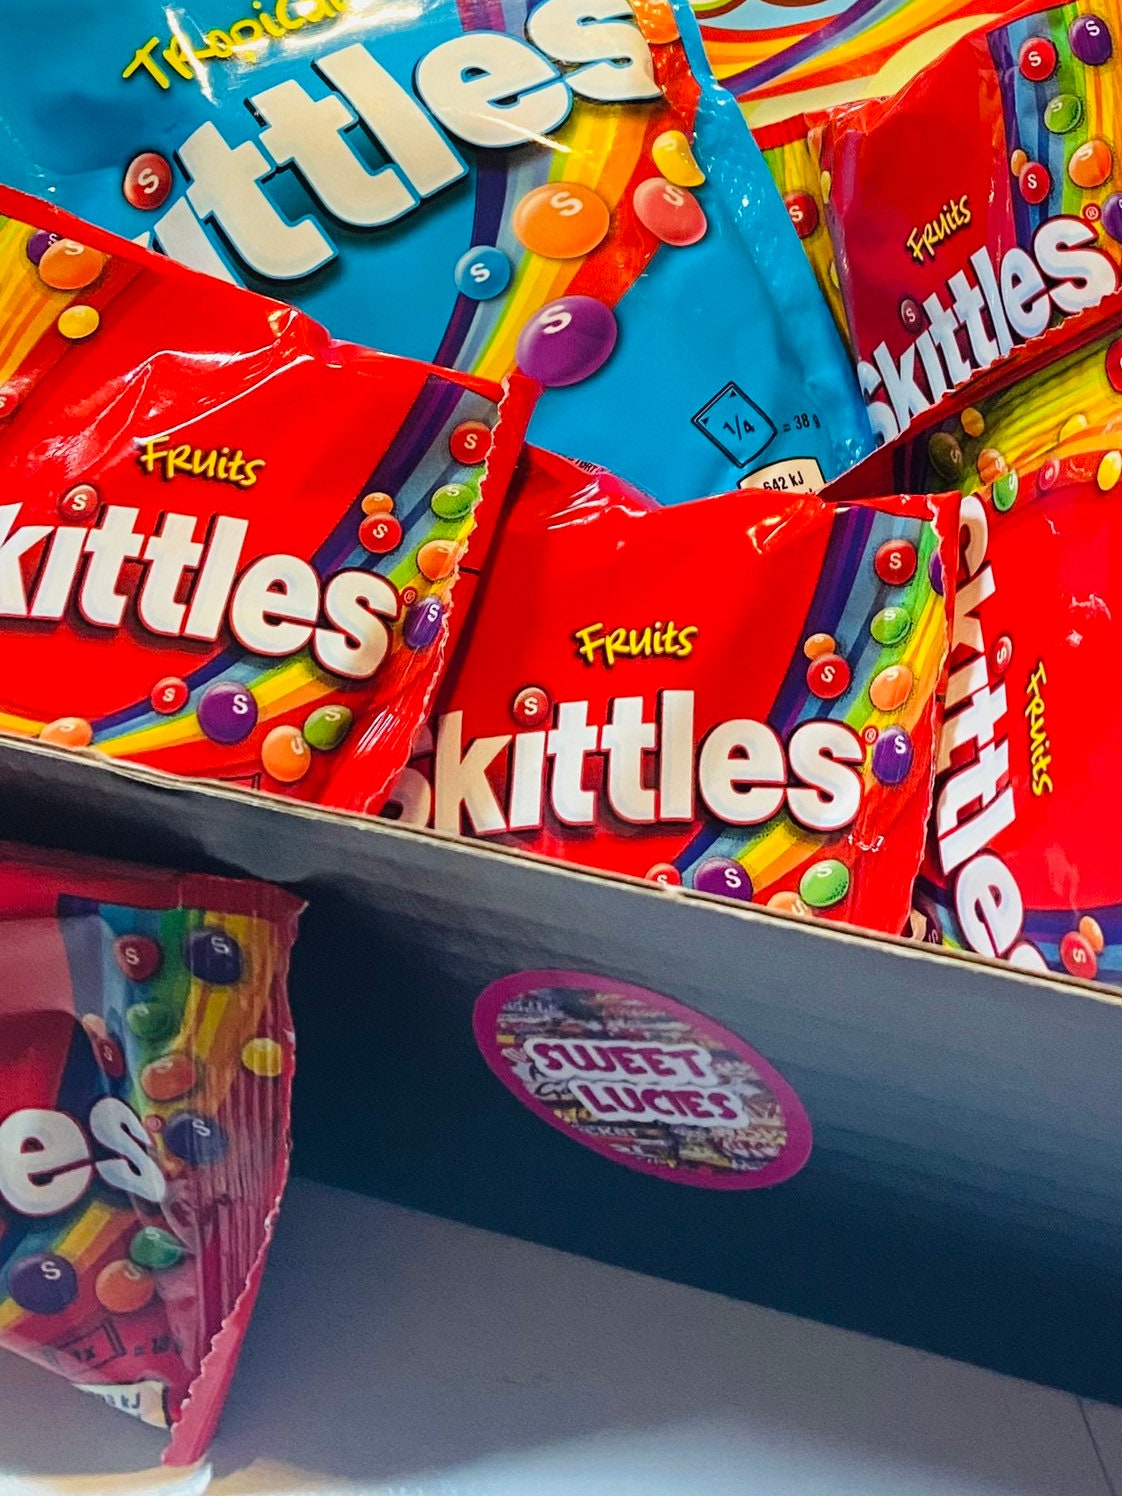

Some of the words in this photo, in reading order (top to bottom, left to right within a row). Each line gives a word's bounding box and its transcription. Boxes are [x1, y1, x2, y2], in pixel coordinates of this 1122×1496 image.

[906, 194, 972, 263] Fruits
[793, 412, 811, 431] 38
[139, 436, 267, 488] Fruits
[0, 502, 399, 681] kittles
[574, 620, 699, 666] Fruits
[1025, 661, 1054, 797] Fruits
[532, 1042, 707, 1078] SWEET
[576, 1083, 738, 1121] LUCIES
